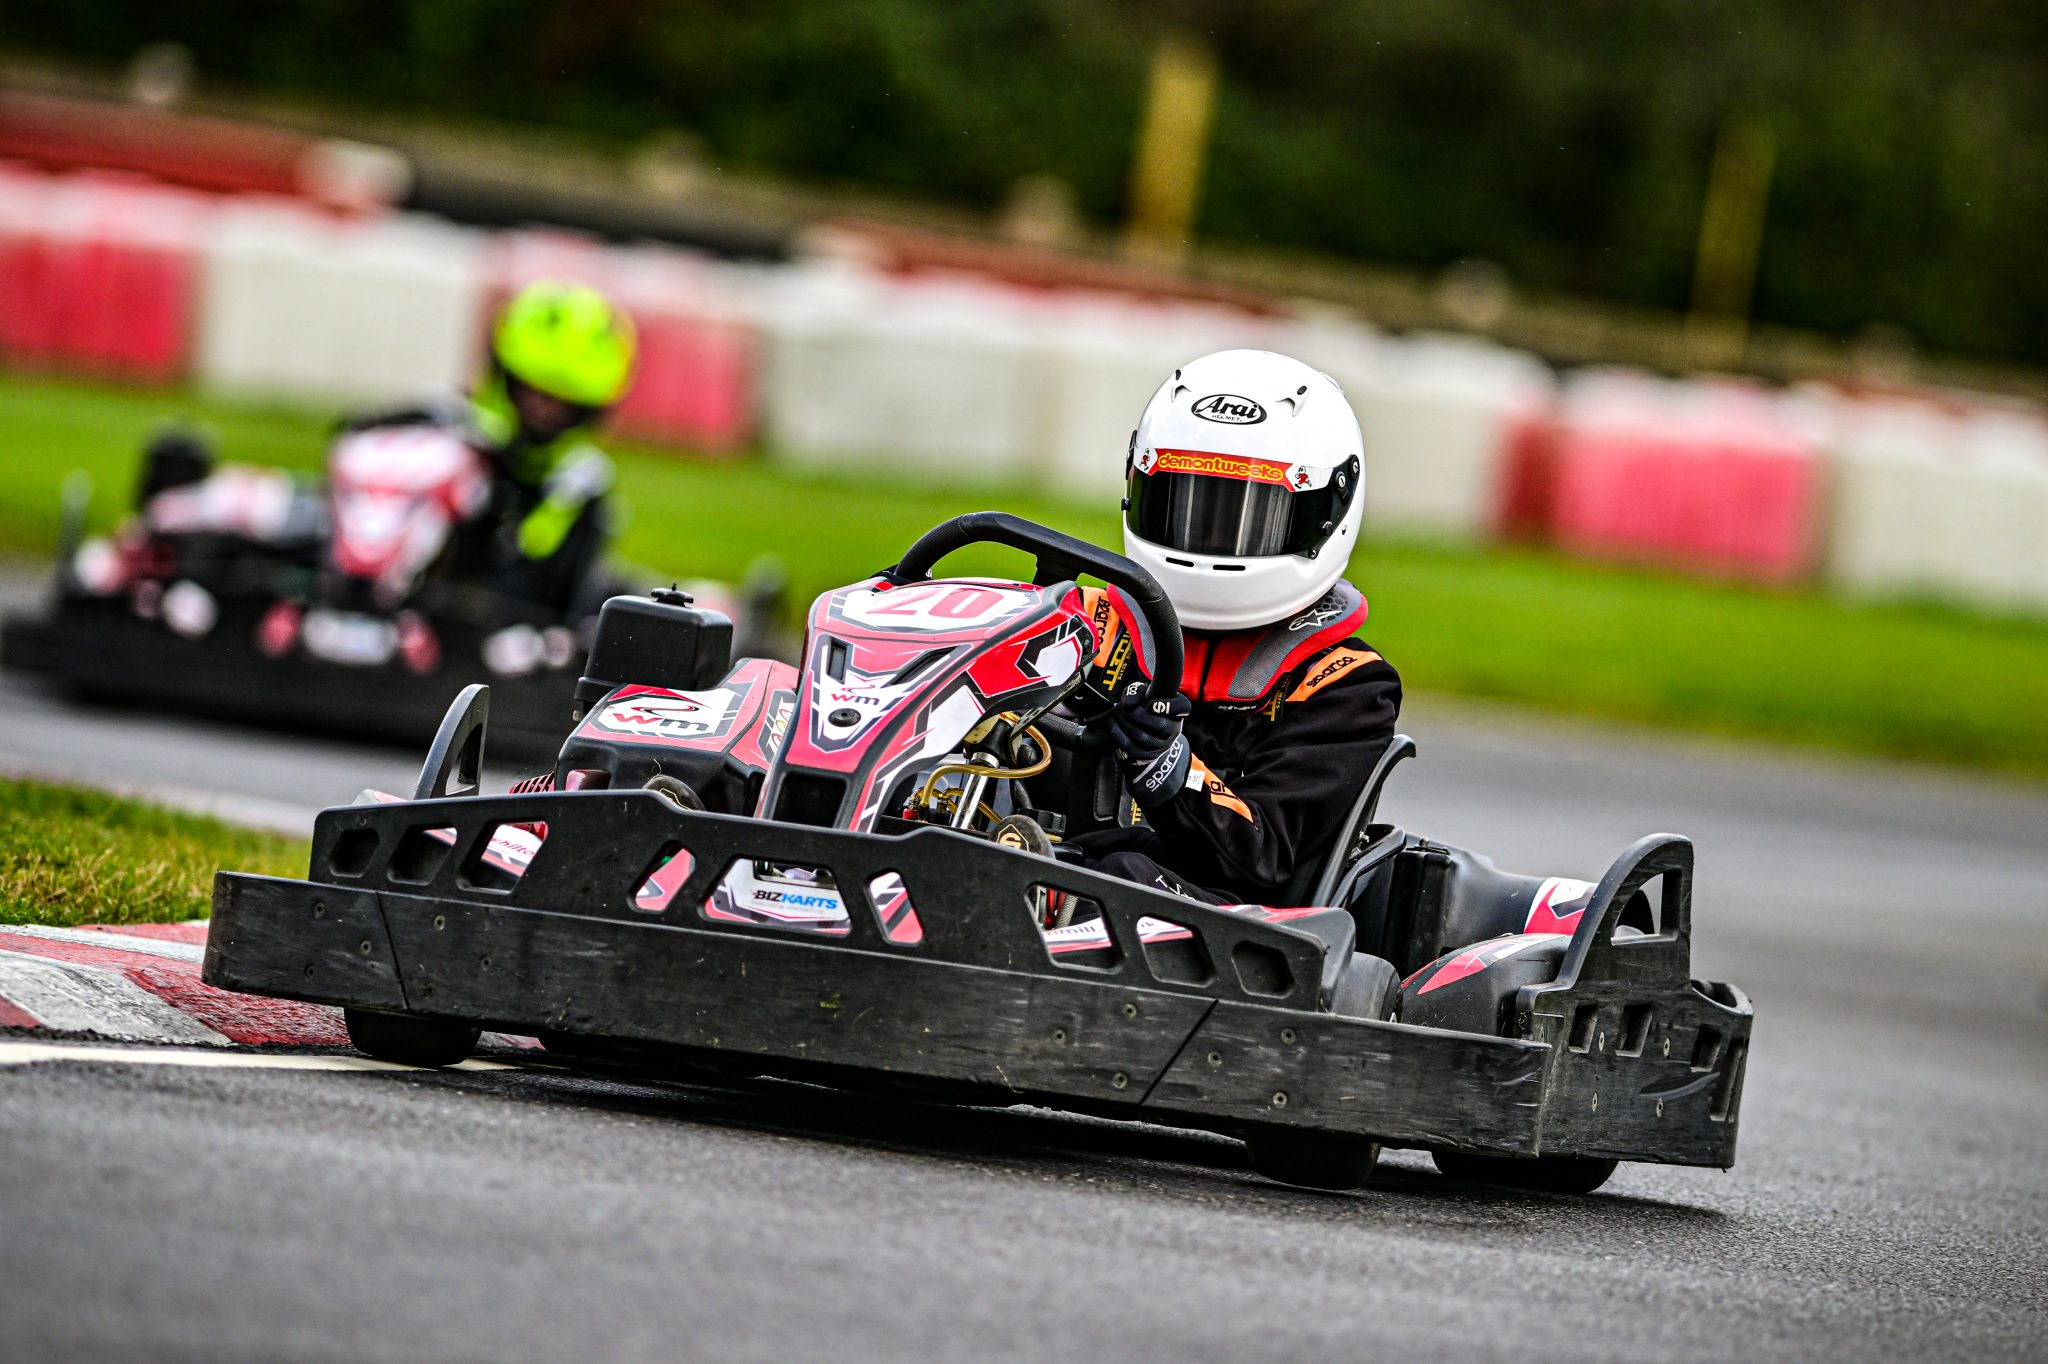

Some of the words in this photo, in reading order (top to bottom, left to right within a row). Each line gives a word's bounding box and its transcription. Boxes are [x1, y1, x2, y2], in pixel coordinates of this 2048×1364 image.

[1195, 396, 1258, 419] Arai
[1158, 453, 1284, 481] demontweeks
[865, 586, 1005, 619] 20
[1306, 655, 1358, 688] sparco
[1145, 740, 1183, 792] sparco
[754, 889, 839, 910] BIZKARTS
